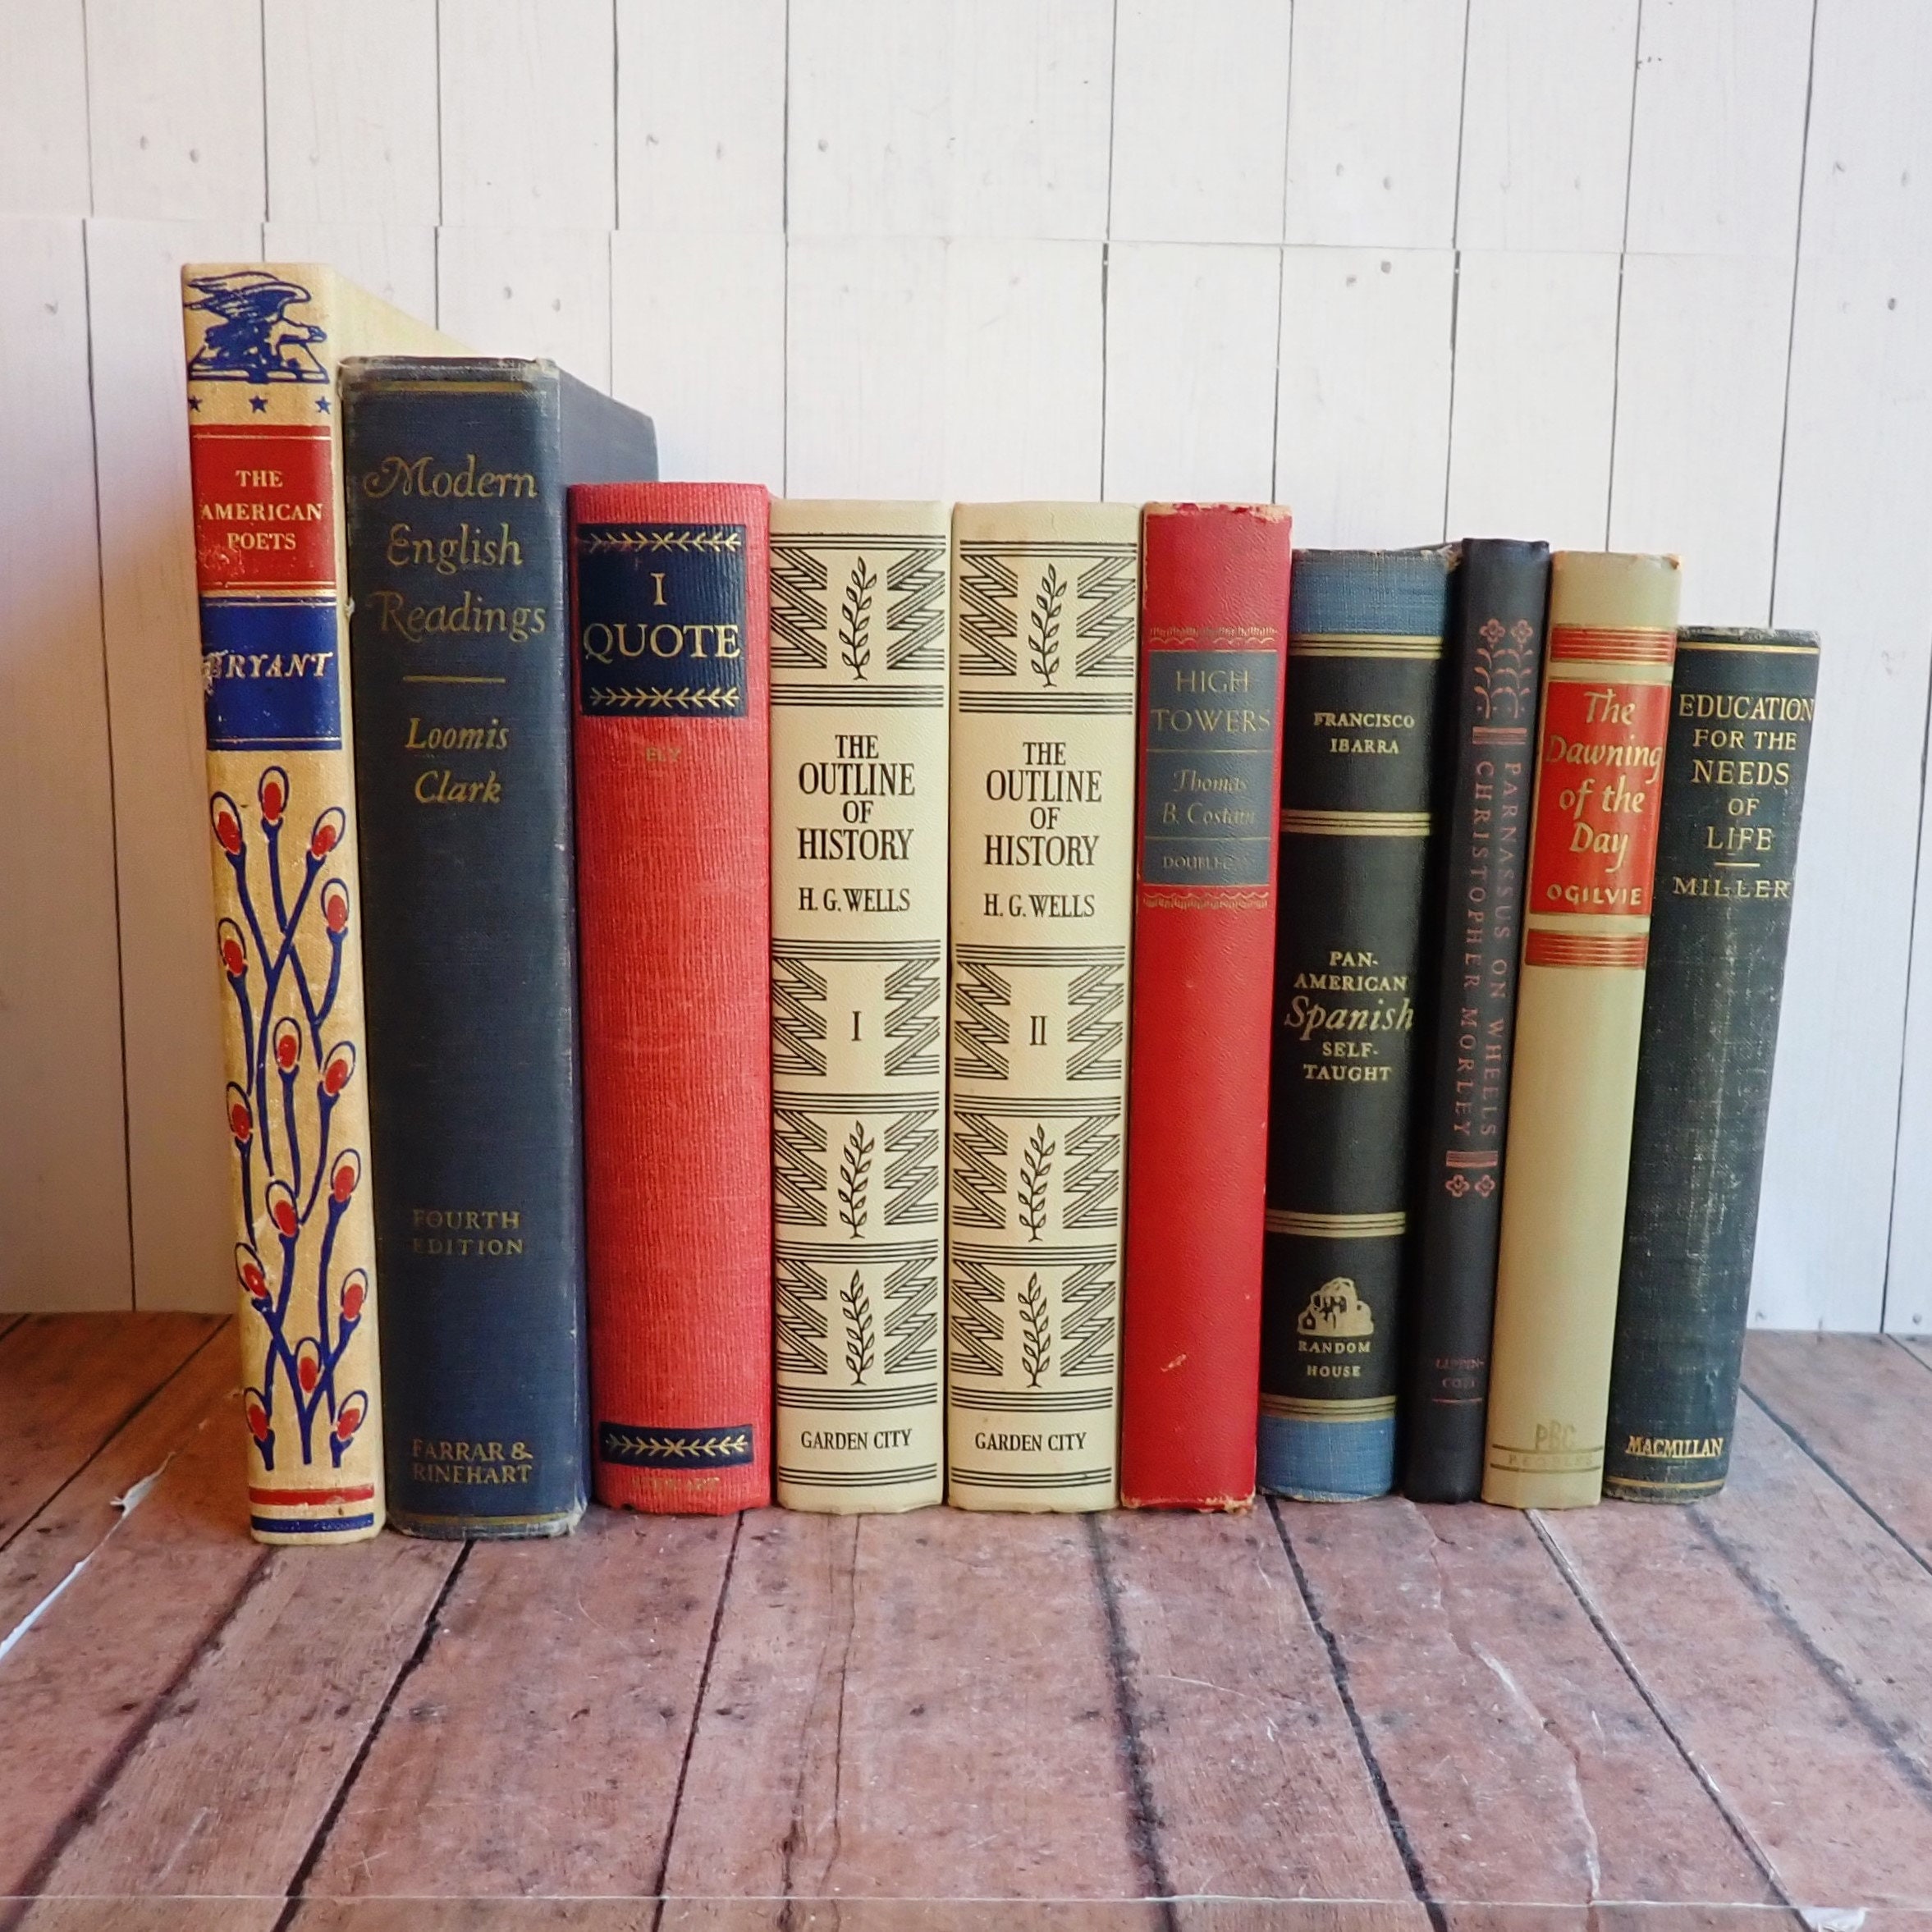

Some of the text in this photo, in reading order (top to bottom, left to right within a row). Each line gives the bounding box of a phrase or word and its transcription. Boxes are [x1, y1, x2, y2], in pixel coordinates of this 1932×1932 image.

[236, 469, 283, 488] THE
[364, 454, 538, 498] Modern
[201, 503, 323, 520] AMERICAN
[227, 533, 296, 551] POETS
[387, 522, 523, 574] English
[650, 573, 666, 606] I
[368, 591, 546, 643] Readings
[583, 624, 740, 664] QUOTE
[204, 650, 333, 679] BRYANT
[1176, 670, 1248, 693] HIGH
[1584, 688, 1633, 725] The
[1678, 693, 1815, 722] EDUCATION
[1150, 709, 1271, 732] TOWERS
[1313, 712, 1415, 729] FRANCISCO
[405, 717, 509, 750] Loomis
[1693, 729, 1797, 751] FOR THE
[835, 735, 879, 759] THE
[1023, 742, 1066, 766] THE
[1330, 738, 1399, 754] IBARRA
[1545, 735, 1664, 785] Dawning
[799, 762, 915, 796] OUTLINE
[1173, 769, 1247, 793] Thomas
[1691, 759, 1790, 786] NEEDS
[414, 770, 501, 803] Clark
[986, 770, 1102, 803] OUTLINE
[1559, 775, 1646, 819] of the
[842, 800, 874, 823] OF
[1030, 807, 1060, 830] OF
[1728, 797, 1760, 817] OF
[797, 828, 913, 860] HISTORY
[985, 835, 1100, 867] HISTORY
[1570, 822, 1629, 873] Day
[1706, 826, 1774, 852] LIFE
[799, 887, 910, 912] H. G. WELLS
[1546, 883, 1642, 906] OGILVIE
[1672, 876, 1792, 899] MILLER
[983, 893, 1095, 918] H. G. WELLS
[1329, 950, 1379, 967] PAN-
[1454, 761, 1494, 1136] CHRISTOPHER MORLEY
[1481, 762, 1521, 1136] PARNASSUS ON WHEELS
[1293, 973, 1408, 991] AMERICAN
[850, 1011, 862, 1042] I
[1029, 1014, 1047, 1046] II
[1284, 996, 1414, 1041] Spanish
[1322, 1042, 1379, 1058] SELF-
[1303, 1064, 1392, 1082] TAUGHT
[412, 1209, 521, 1229] FOURTH
[413, 1238, 524, 1256] EDITION
[1298, 1340, 1371, 1353] RANDOM
[1307, 1365, 1361, 1377] HOUSE
[413, 1439, 533, 1462] FARRAR &
[801, 1428, 912, 1450] GARDEN CITY
[975, 1431, 1087, 1452] GARDEN CITY
[1625, 1435, 1724, 1458] MACMILLAN
[413, 1463, 532, 1484] RINEHART
